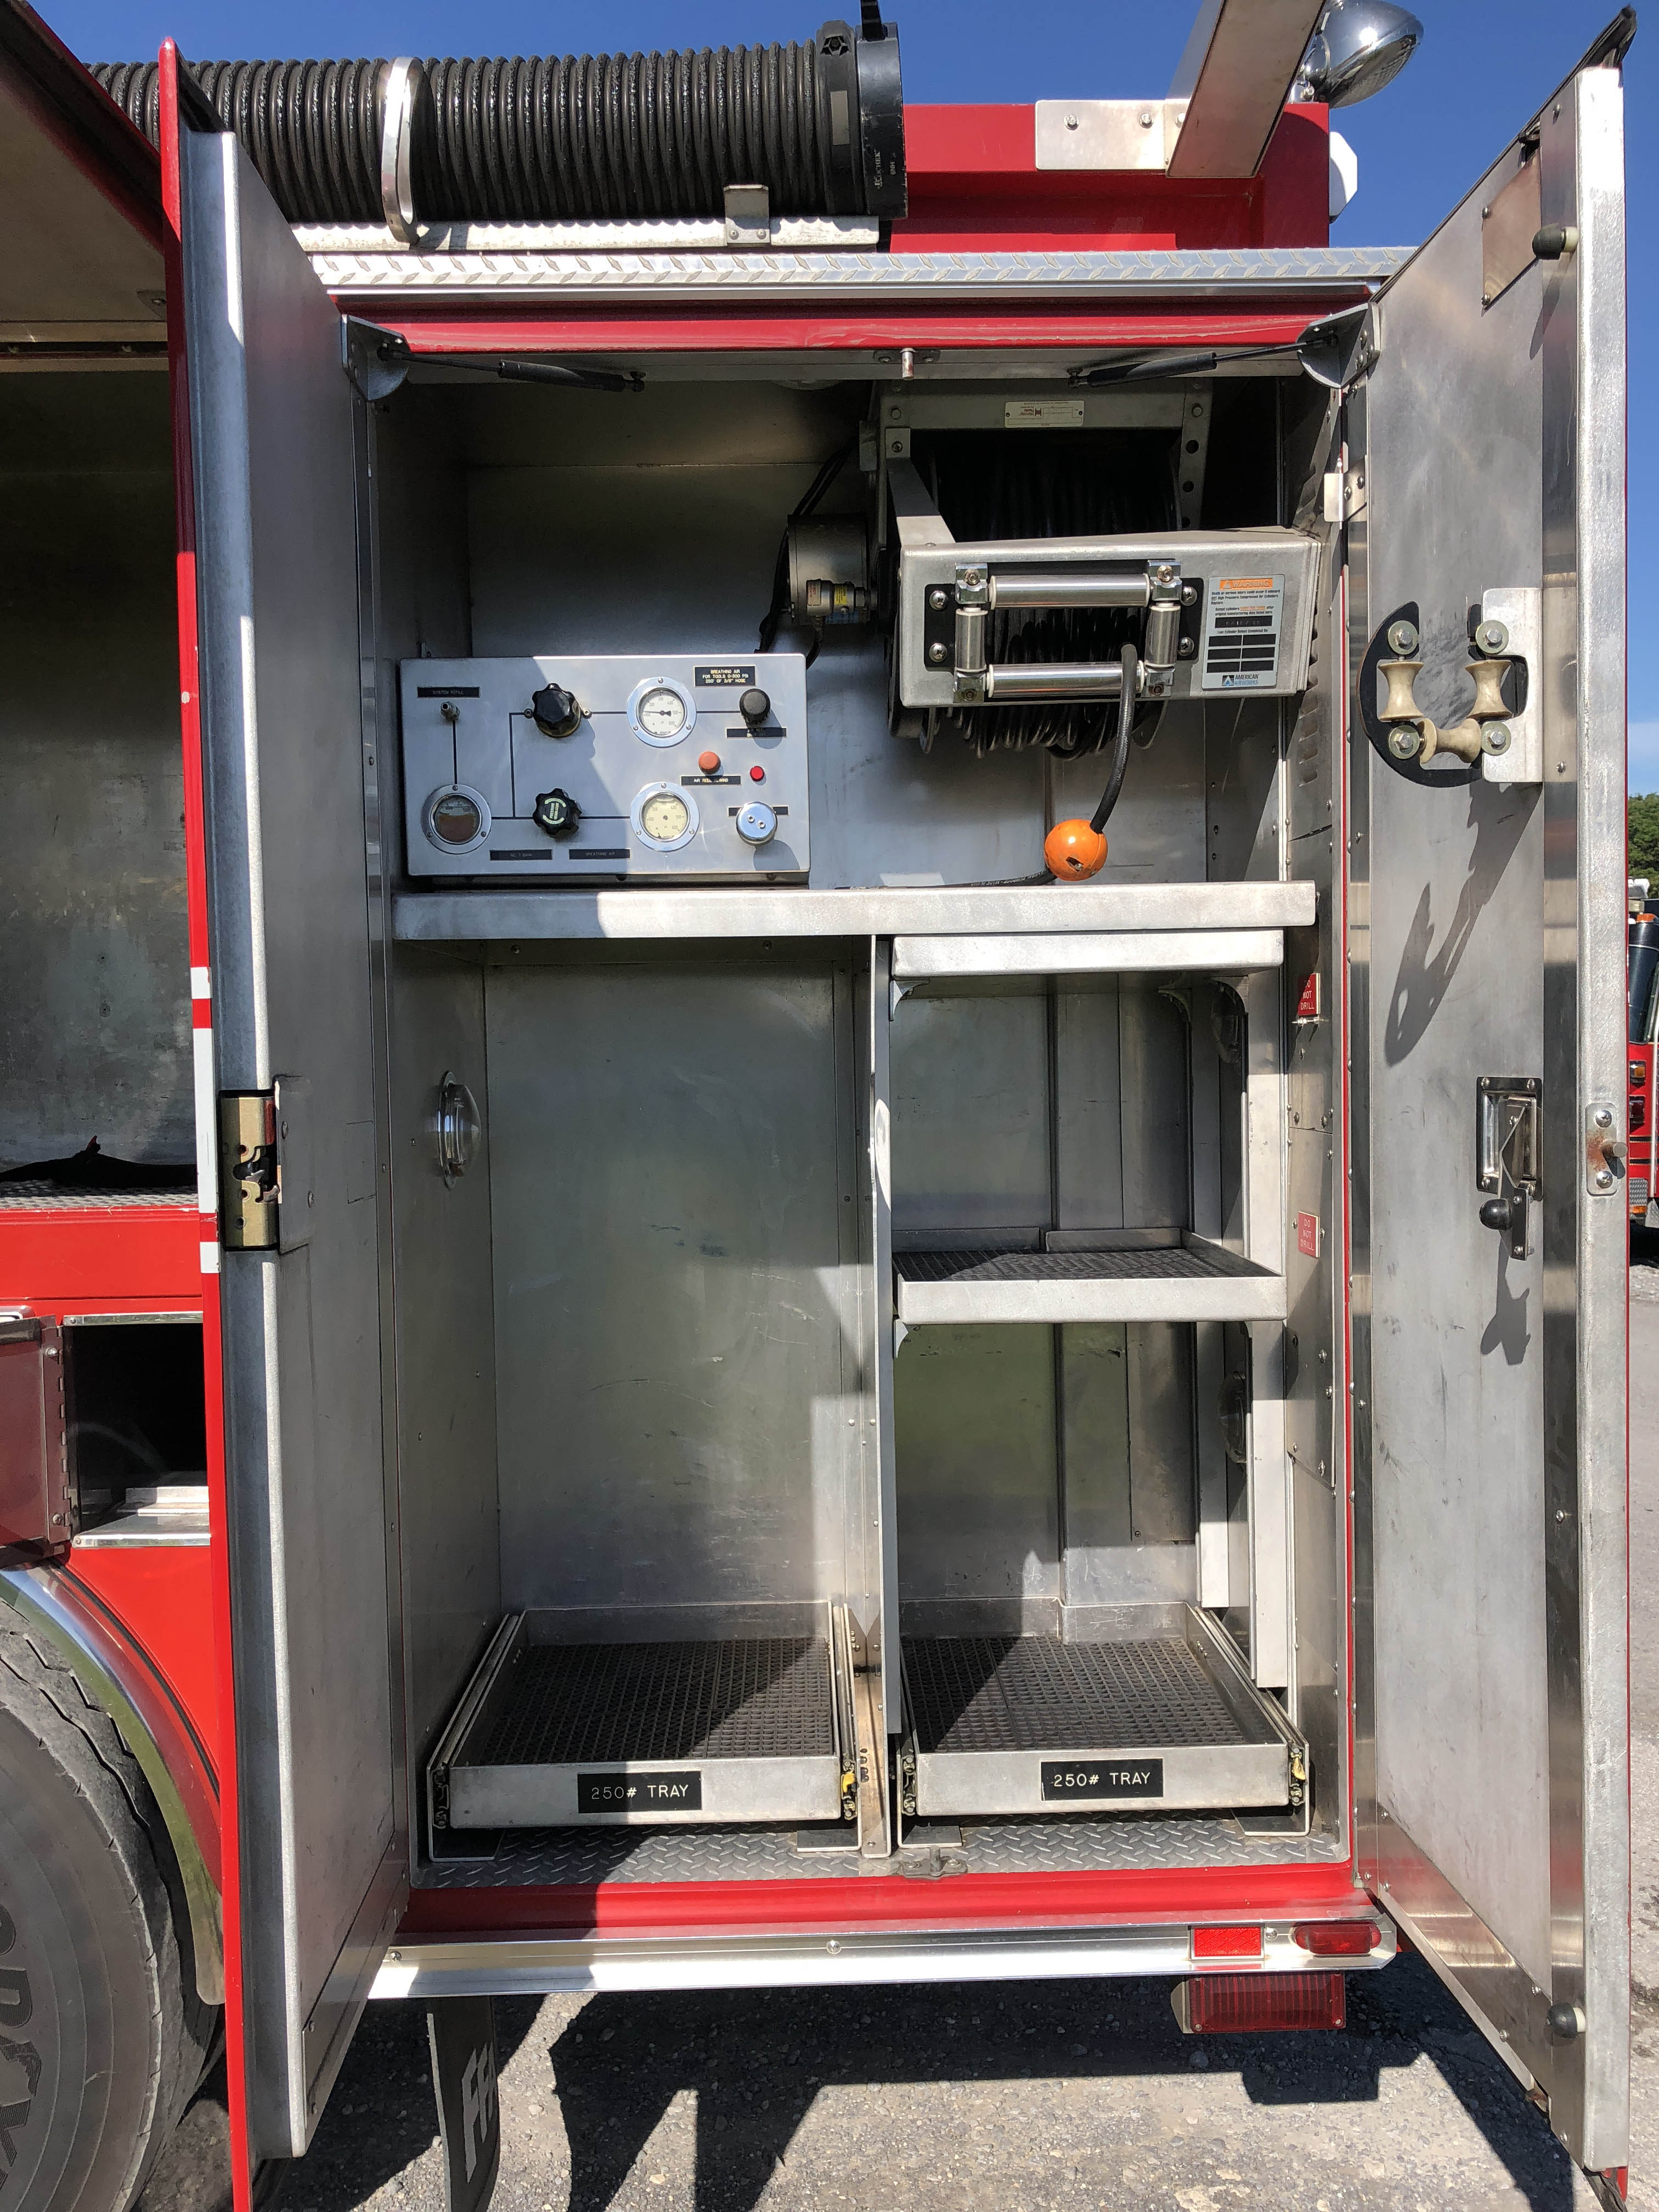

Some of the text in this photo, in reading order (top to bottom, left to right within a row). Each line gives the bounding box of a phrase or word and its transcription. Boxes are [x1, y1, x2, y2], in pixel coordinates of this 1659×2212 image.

[1302, 990, 1312, 999] NOT
[1300, 1002, 1314, 1011] DRILL
[1304, 1218, 1311, 1228] DO
[1302, 1229, 1312, 1239] NOT
[1300, 1239, 1314, 1251] DRILL
[1053, 1771, 1150, 1787] 250# TRAY
[591, 1784, 689, 1800] 250# TRAY
